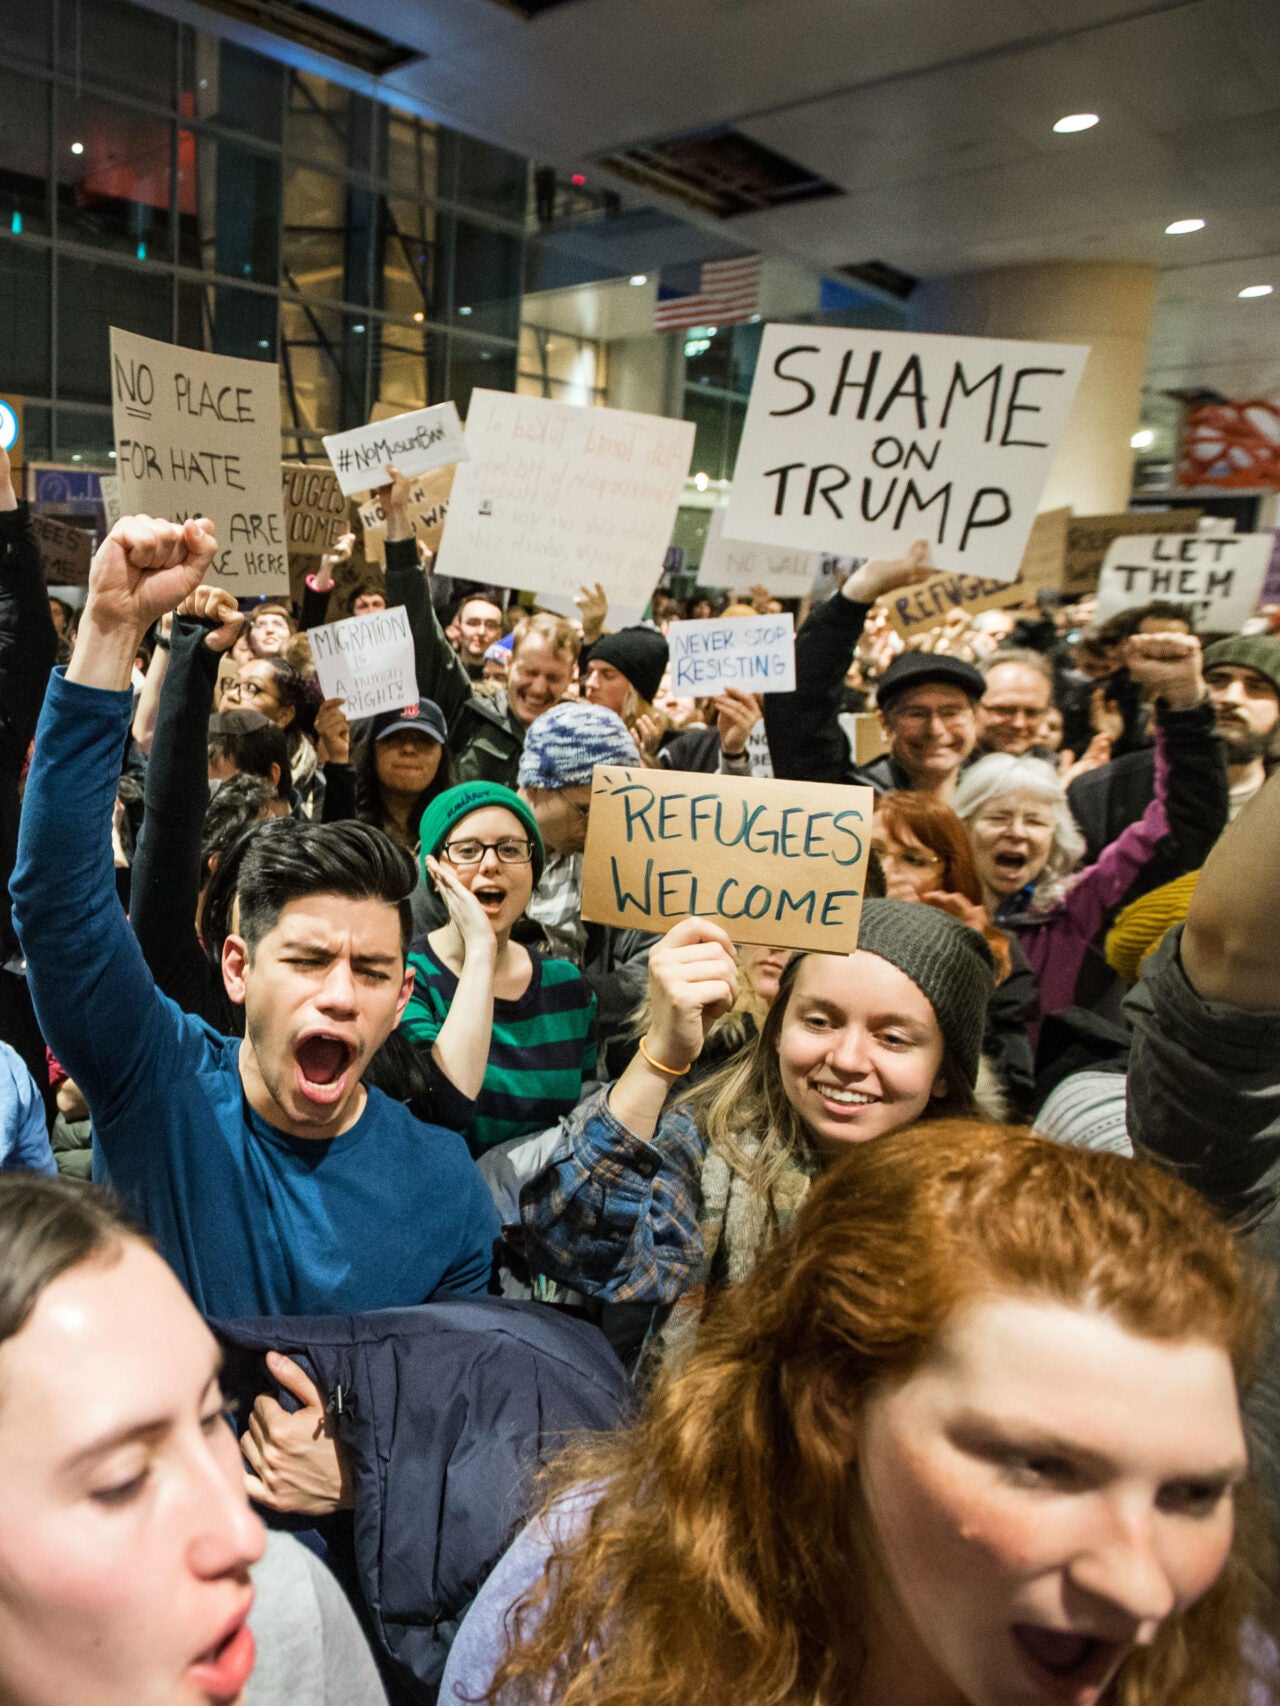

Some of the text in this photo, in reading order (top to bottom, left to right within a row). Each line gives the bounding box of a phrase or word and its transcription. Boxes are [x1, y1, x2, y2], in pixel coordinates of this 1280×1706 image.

[114, 352, 256, 423] NO PLACE
[769, 345, 1065, 450] SHAME
[119, 439, 246, 491] FOR HATE
[871, 436, 941, 471] ON
[764, 463, 1011, 553] TRUMP
[230, 513, 282, 546] ARE
[1152, 536, 1240, 563] LET
[244, 551, 287, 576] HERE
[1115, 564, 1236, 598] THEM
[313, 611, 407, 659] MIGRATION
[675, 625, 787, 655] NEVER STOP
[677, 653, 786, 687] RESISTING
[611, 784, 865, 867] REFUGEES
[611, 855, 858, 927] WELCOME
